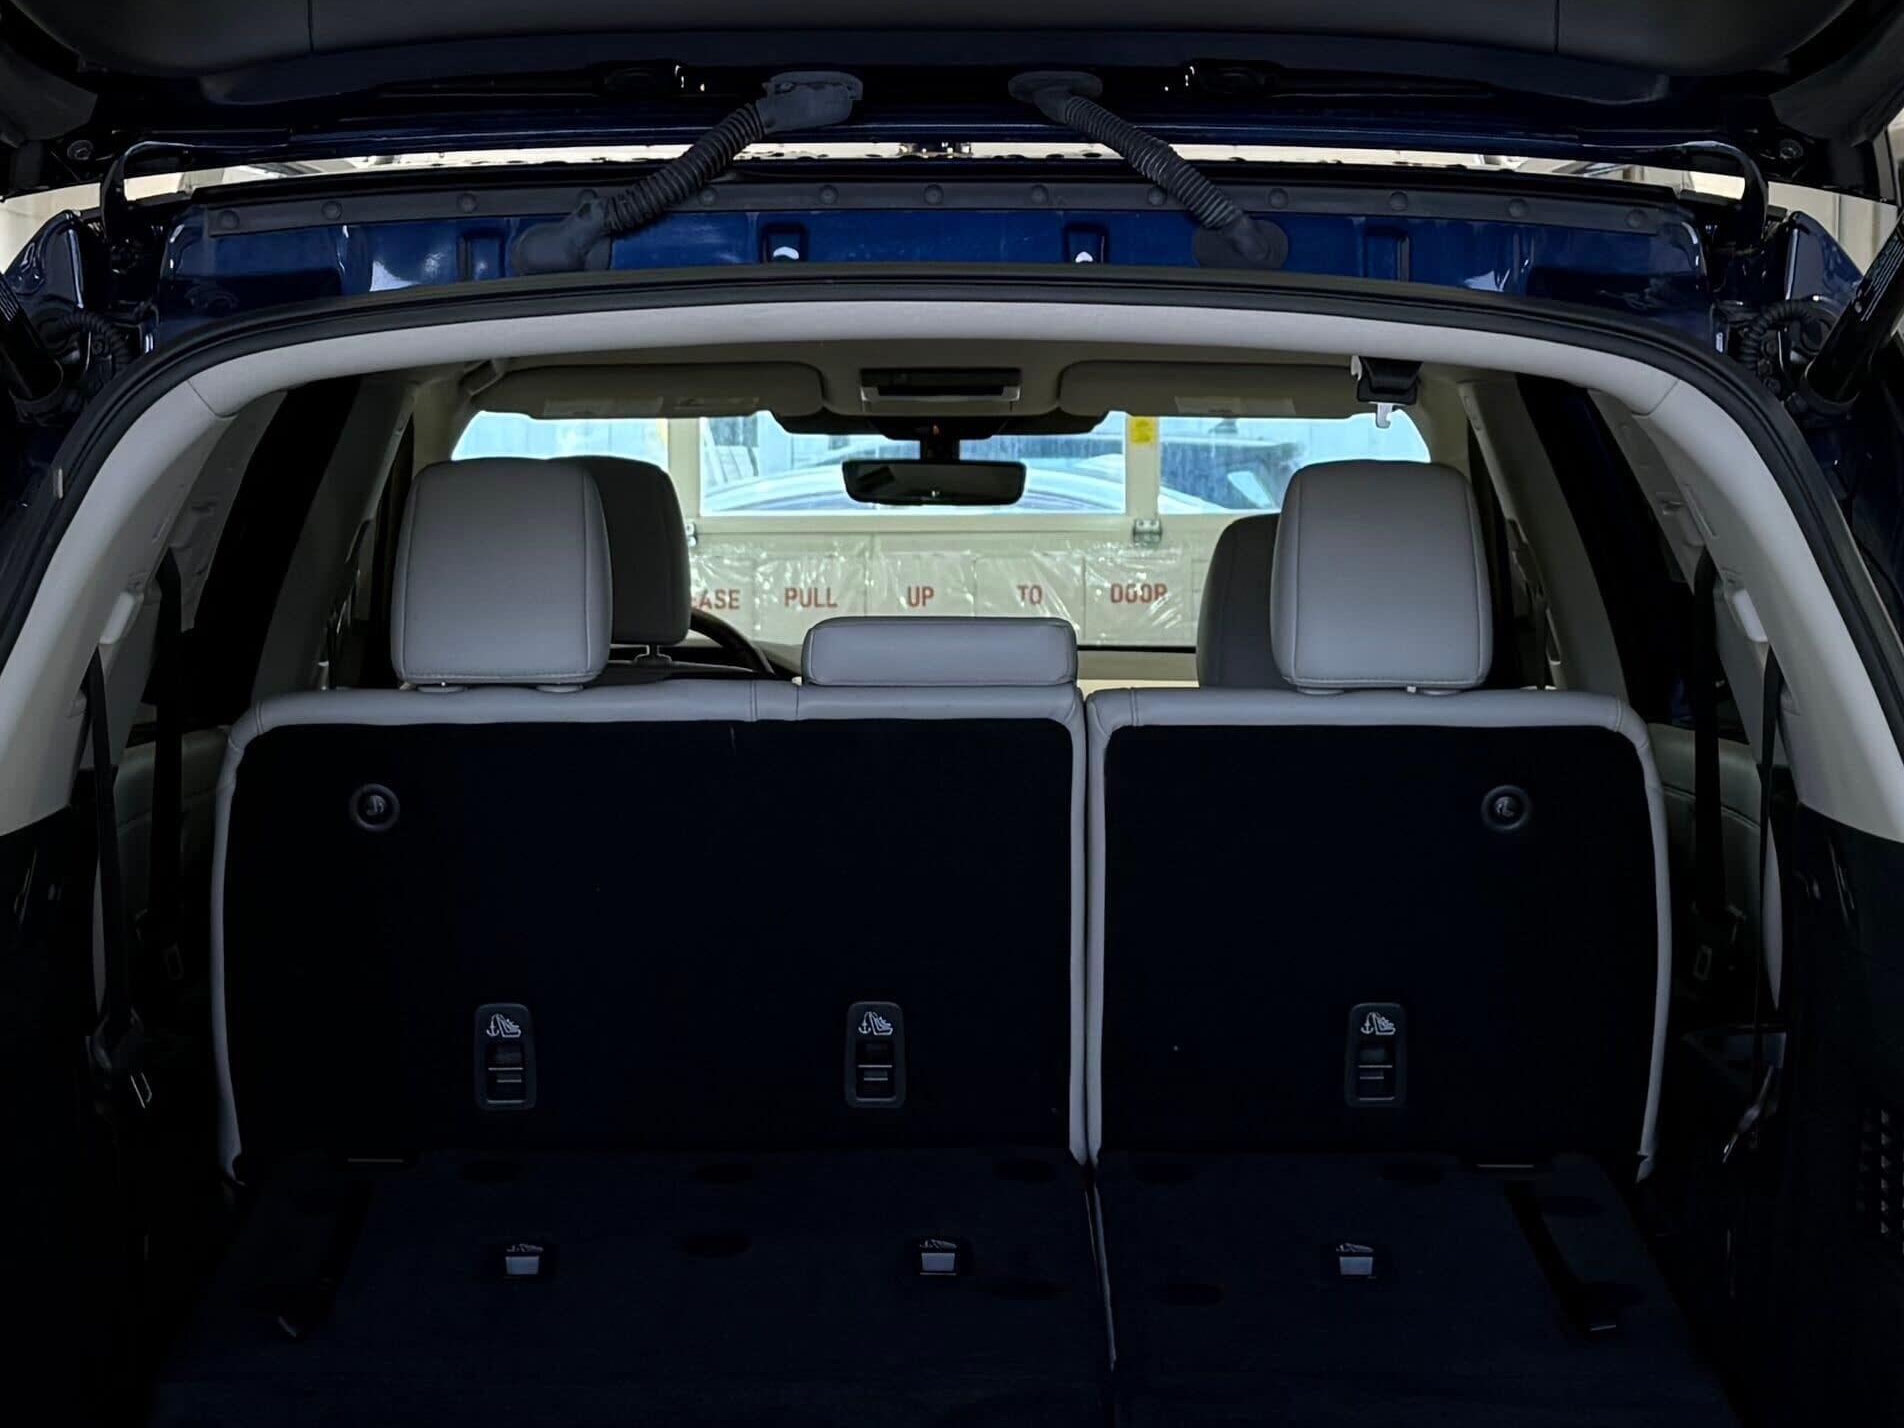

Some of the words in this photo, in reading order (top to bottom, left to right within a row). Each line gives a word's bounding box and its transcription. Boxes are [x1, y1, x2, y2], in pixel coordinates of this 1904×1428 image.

[784, 587, 838, 608] PULL
[907, 586, 935, 608] UP
[1017, 585, 1043, 605] TO
[1110, 583, 1168, 603] DOOR
